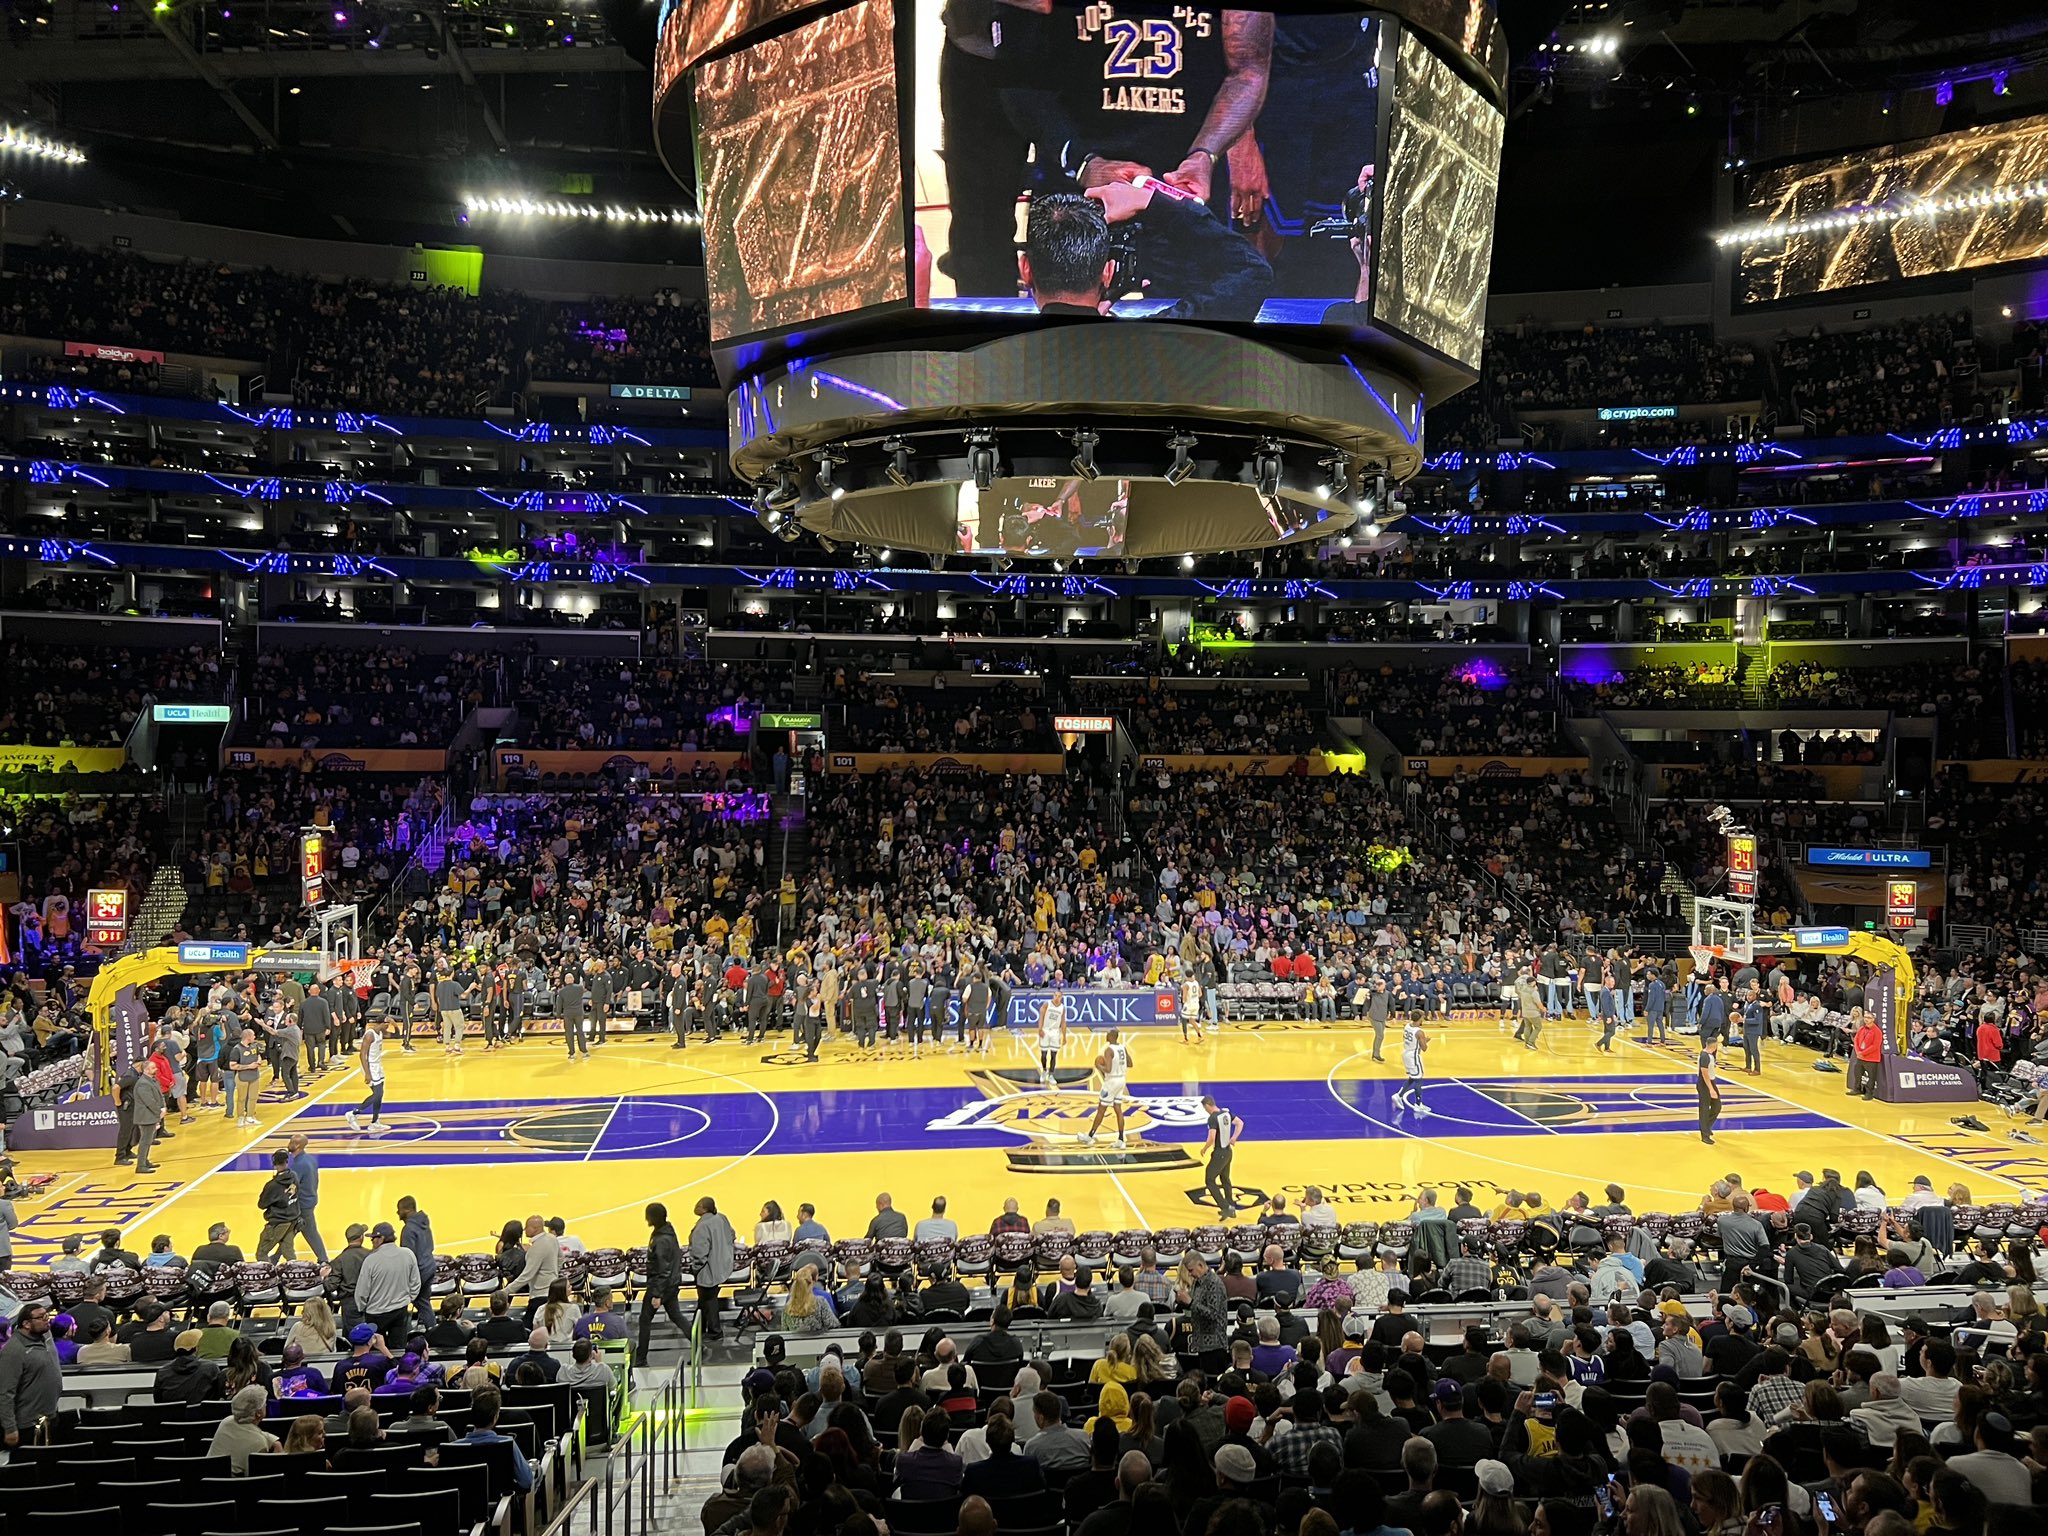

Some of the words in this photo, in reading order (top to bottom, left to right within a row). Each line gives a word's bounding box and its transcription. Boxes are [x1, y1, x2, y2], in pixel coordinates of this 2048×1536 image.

[1104, 19, 1182, 79] 23
[1102, 87, 1186, 114] LAKERS
[97, 347, 134, 360] boldyn
[635, 387, 680, 399] DELTA
[1612, 407, 1675, 421] crypto.com
[1029, 478, 1057, 489] LAKERS
[167, 707, 188, 718] UCLA
[191, 707, 221, 719] Health
[1056, 718, 1110, 731] TOSHIBA
[233, 753, 251, 762] 118
[503, 754, 520, 764] 119
[836, 757, 853, 766] 101
[1146, 759, 1164, 769] 102
[1410, 760, 1428, 769] 103
[1732, 852, 1750, 870] 24
[1872, 853, 1910, 864] ULTRA
[1894, 894, 1909, 905] 24
[97, 905, 117, 917] 24
[1822, 934, 1845, 944] Health
[211, 949, 240, 960] Health
[1063, 995, 1142, 1022] BANK
[1154, 1013, 1177, 1021] TOYOTA
[1915, 1073, 1960, 1081] PECHANGA
[56, 1110, 118, 1121] PECHANGA
[57, 1119, 87, 1127] RESORT
[1302, 1194, 1419, 1204] RENA
[1681, 1220, 1702, 1228] DELTA
[1126, 1239, 1149, 1247] DELTA
[1165, 1237, 1188, 1245] DELTA
[926, 1246, 951, 1255] DELTA
[967, 1243, 991, 1252] DELTA
[764, 1249, 789, 1258] DELTA
[595, 1258, 621, 1266] DELTA
[242, 1272, 271, 1280] DELTA
[288, 1270, 317, 1278] DELTA
[59, 1281, 85, 1289] DELTA
[106, 1280, 133, 1288] DELTA
[153, 1277, 181, 1286] DELTA
